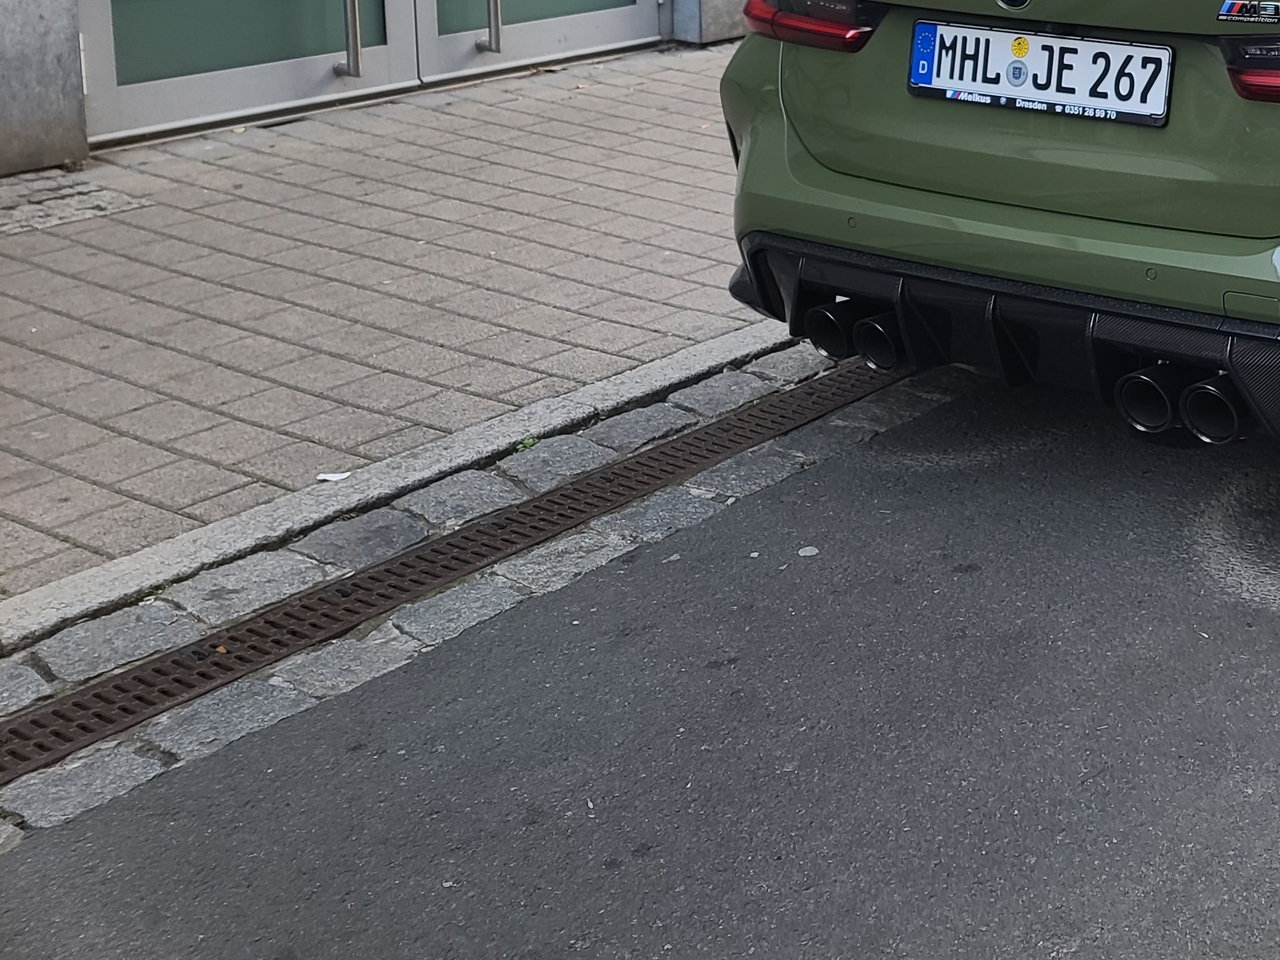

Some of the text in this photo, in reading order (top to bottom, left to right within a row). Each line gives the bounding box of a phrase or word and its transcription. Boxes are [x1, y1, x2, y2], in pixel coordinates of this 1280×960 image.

[1227, 15, 1279, 23] competition
[918, 60, 929, 74] D
[935, 33, 1163, 104] MHL JE 267
[1015, 99, 1048, 111] Dresden
[1064, 105, 1083, 116] 0351
[1084, 107, 1095, 117] 26
[1095, 109, 1106, 119] 99
[1106, 110, 1117, 120] 70
